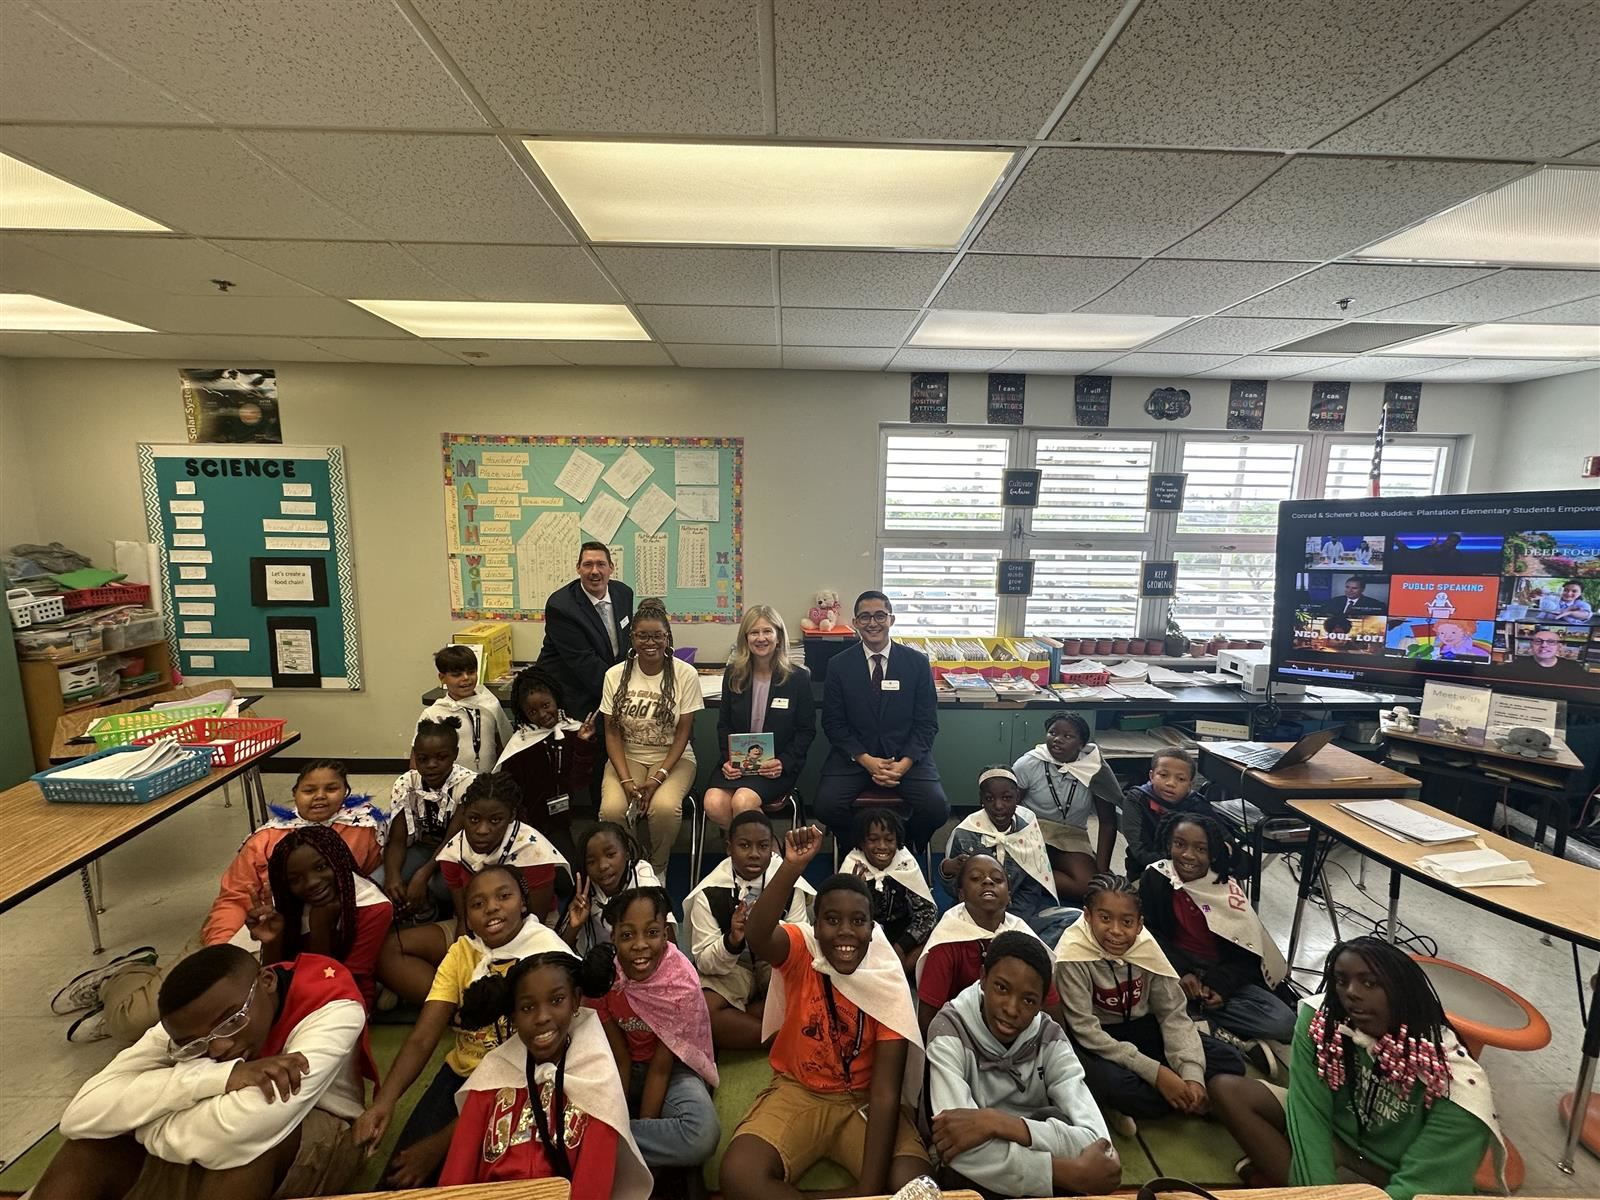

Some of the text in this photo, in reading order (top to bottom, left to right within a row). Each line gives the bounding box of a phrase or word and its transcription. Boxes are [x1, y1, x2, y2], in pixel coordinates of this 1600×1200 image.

[1320, 411, 1345, 420] BEST
[186, 416, 198, 440] Solar
[185, 458, 296, 478] SCIENCE
[1008, 480, 1034, 488] Cultivate
[1416, 508, 1459, 516] Plantation
[1460, 507, 1511, 516] Elementary
[1513, 506, 1556, 514] Students
[1523, 548, 1560, 557] DEEP
[1154, 570, 1168, 579] KEEP
[1146, 580, 1173, 589] GROWING
[1402, 582, 1484, 592] PUBLIC SPEAKING
[1294, 630, 1318, 638] NEO
[1322, 632, 1353, 641] SOUL
[1432, 689, 1456, 701] Meet
